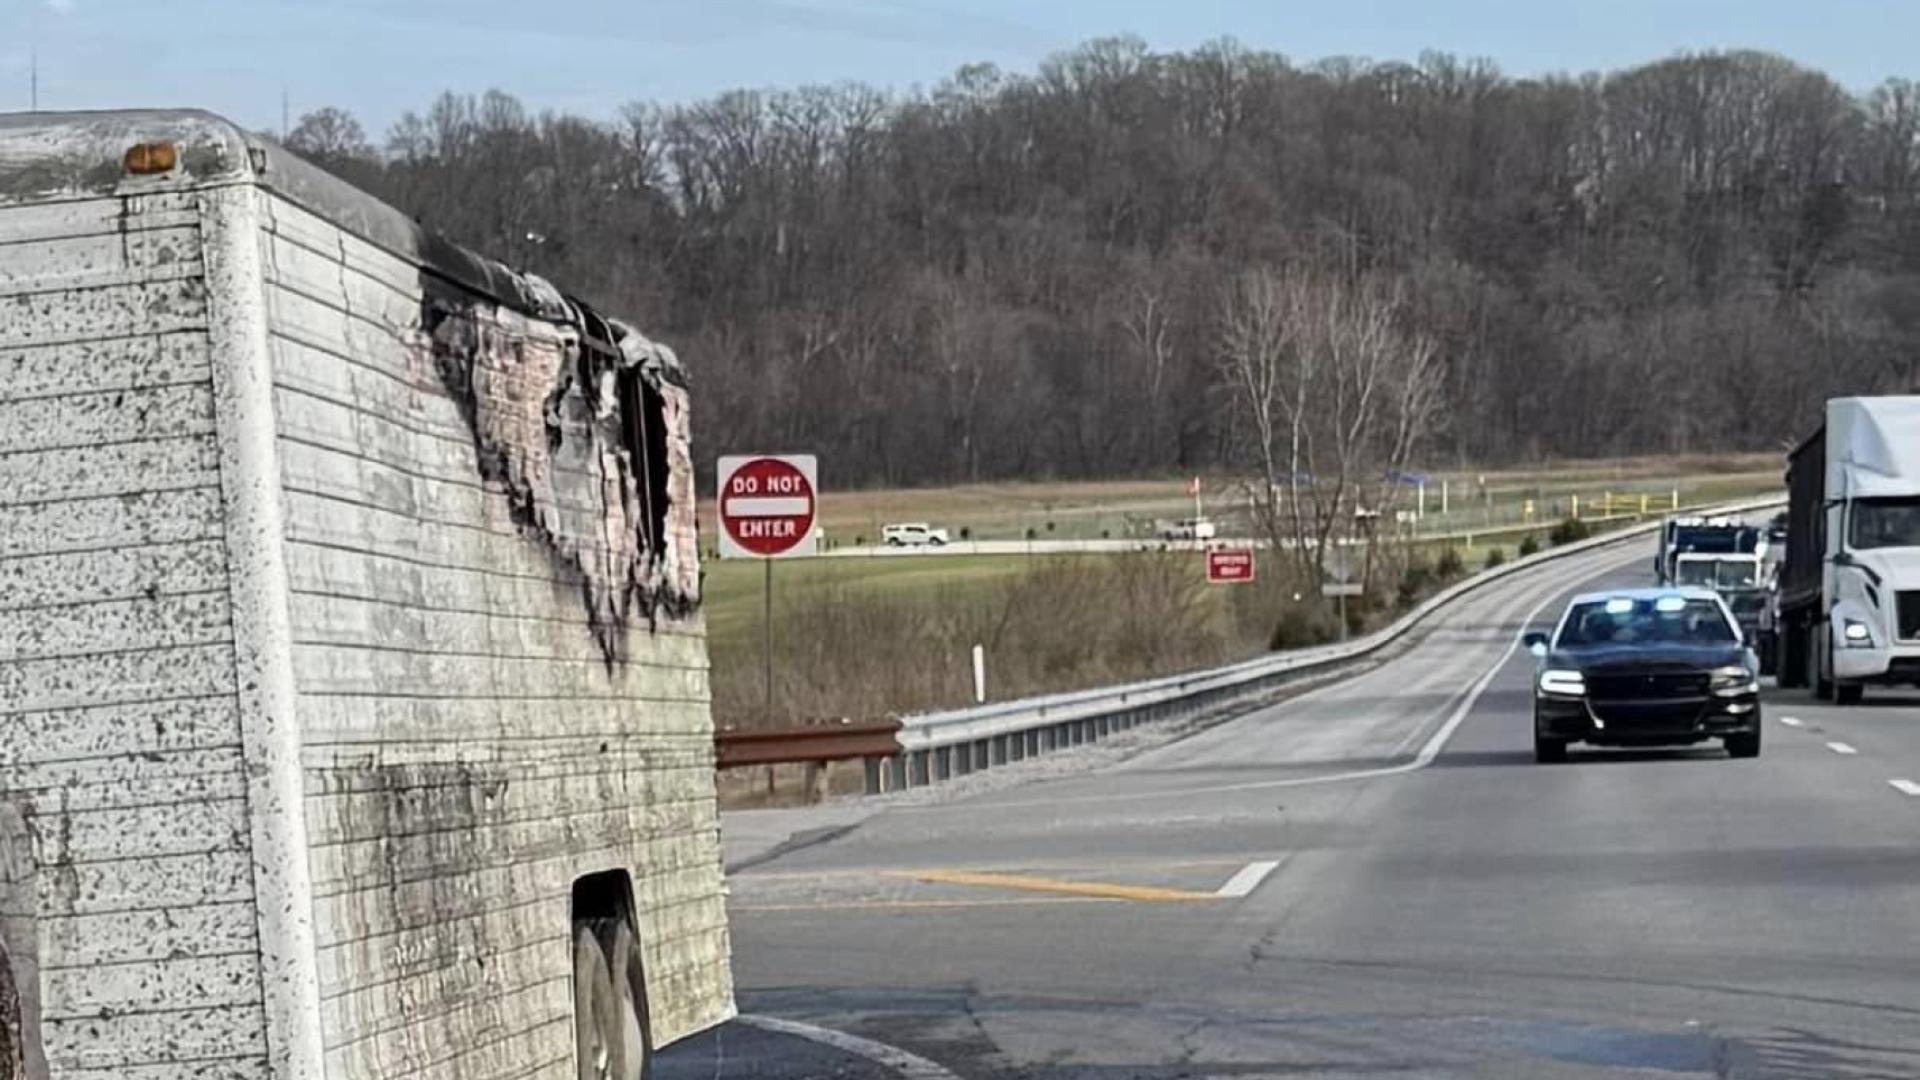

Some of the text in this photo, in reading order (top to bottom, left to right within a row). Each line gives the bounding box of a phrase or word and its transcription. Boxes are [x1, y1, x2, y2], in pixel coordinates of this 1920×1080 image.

[733, 475, 801, 493] DO NOT
[740, 520, 796, 538] ENTER
